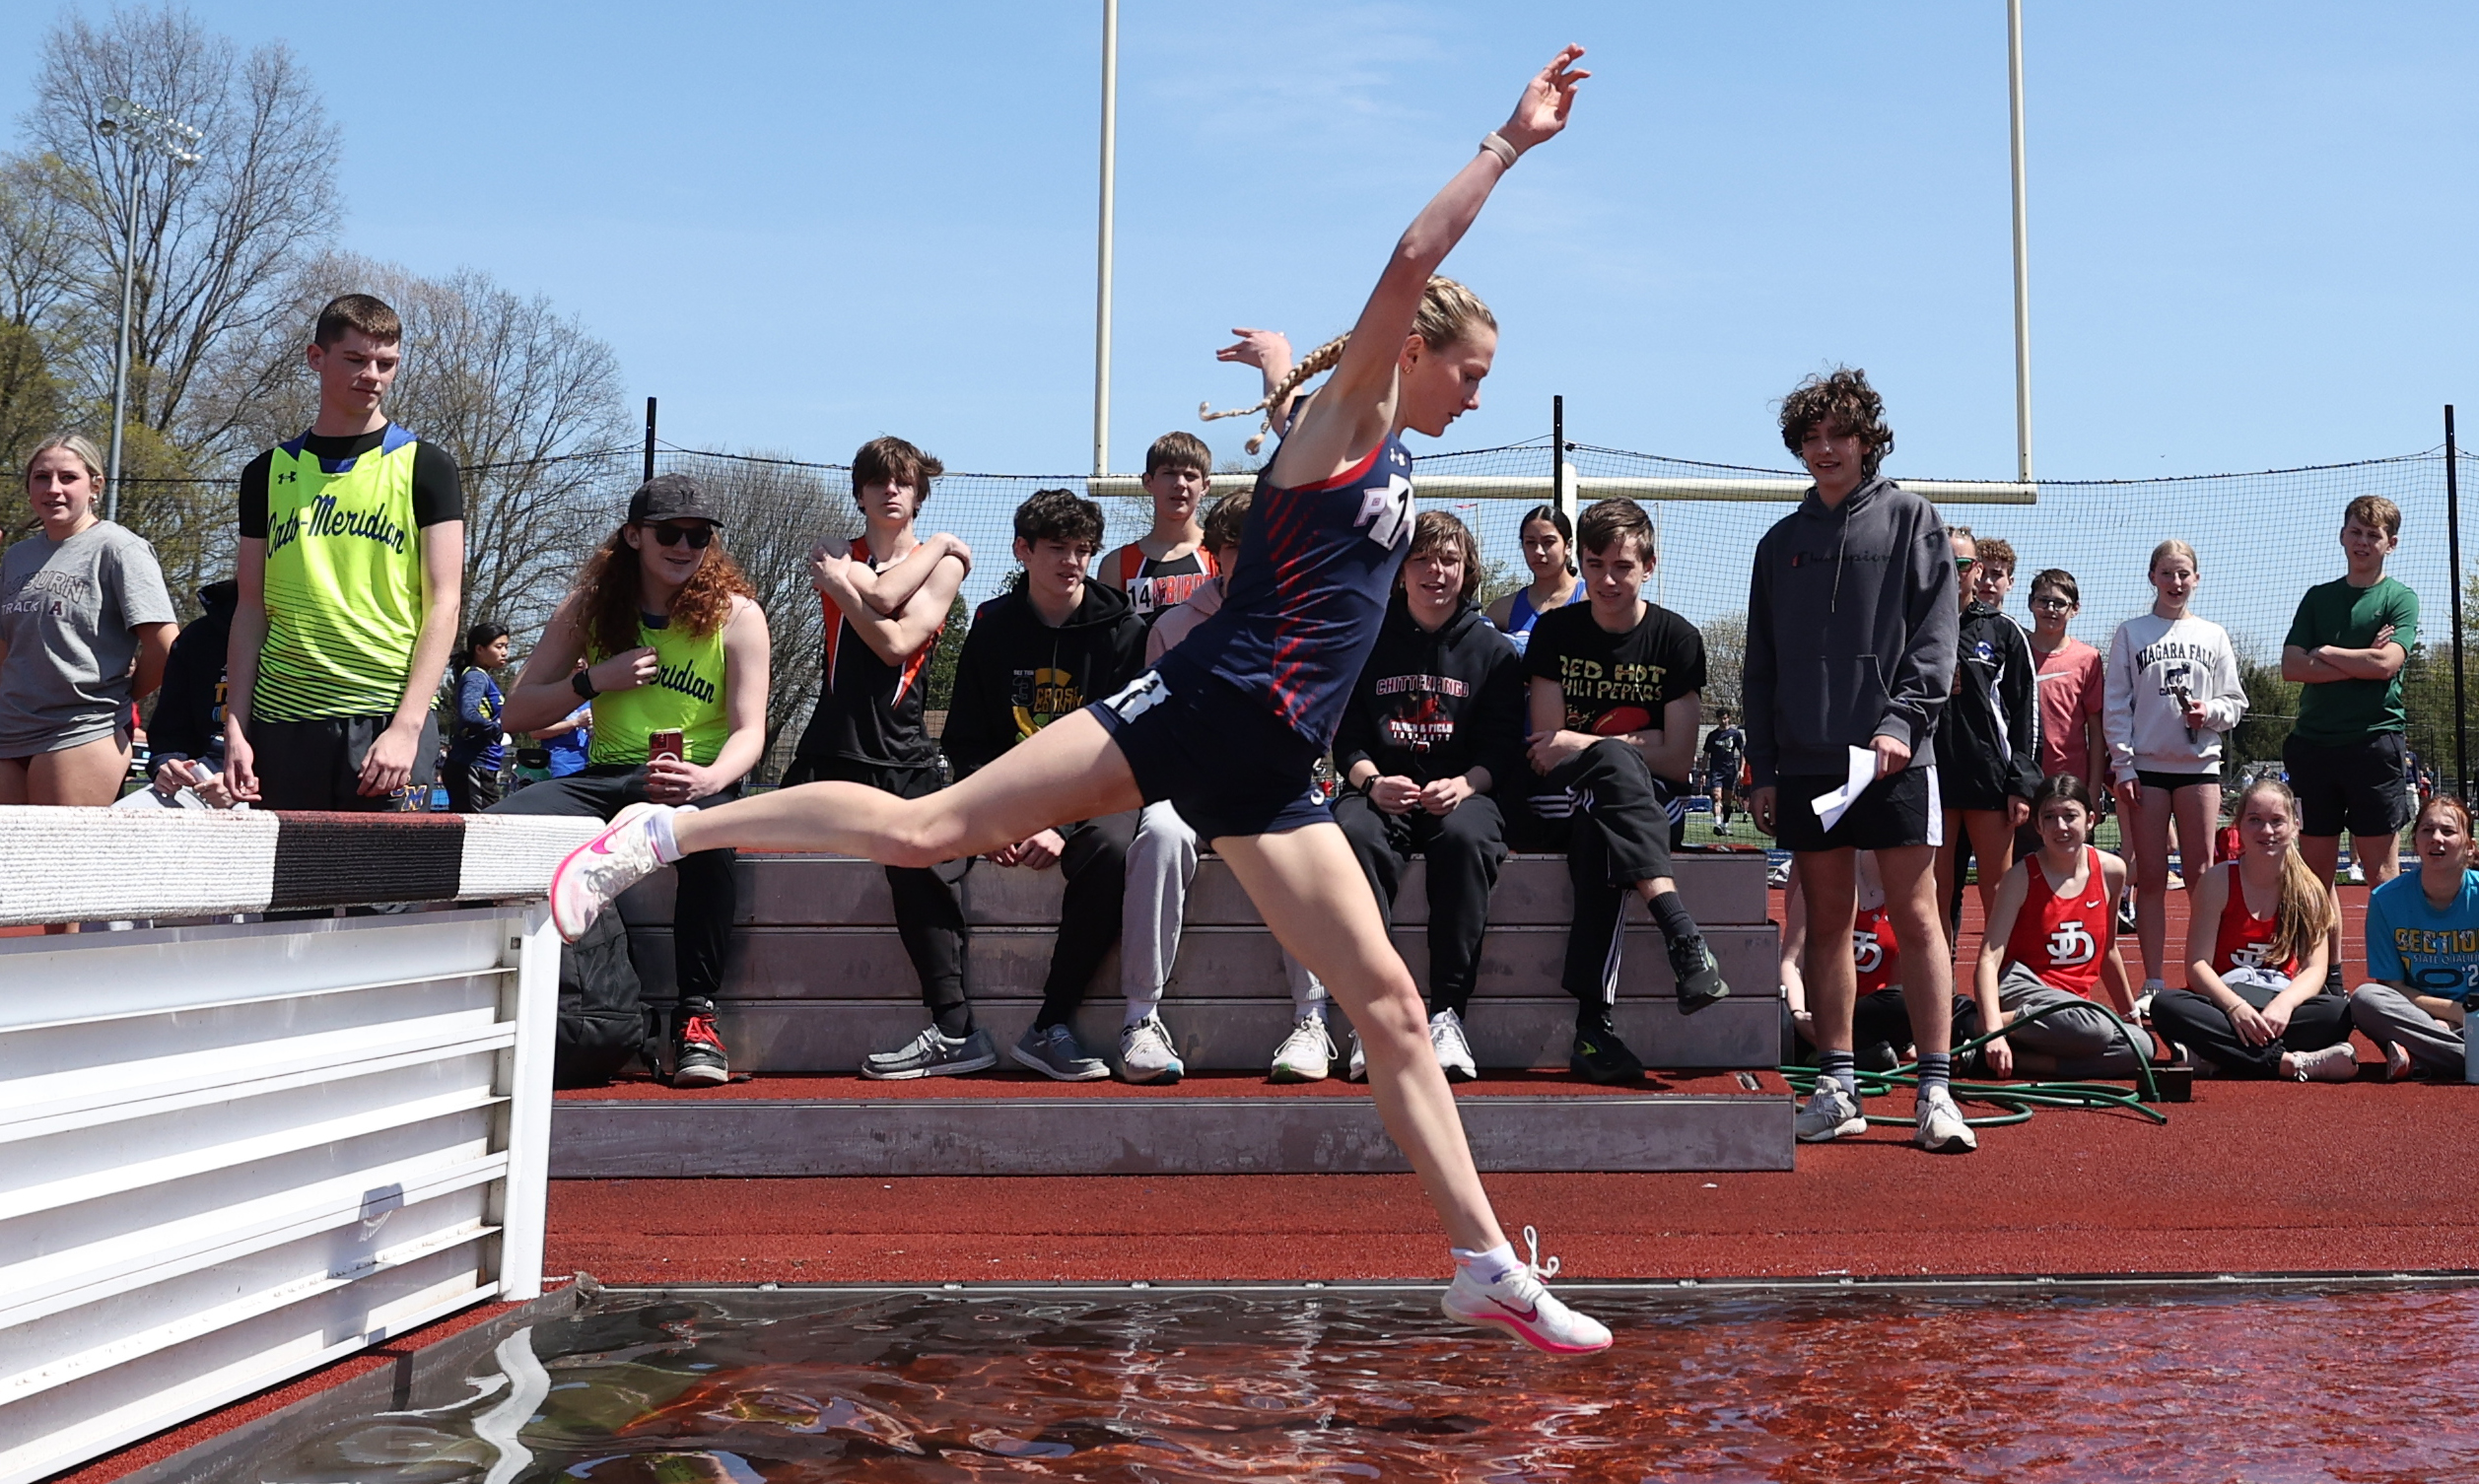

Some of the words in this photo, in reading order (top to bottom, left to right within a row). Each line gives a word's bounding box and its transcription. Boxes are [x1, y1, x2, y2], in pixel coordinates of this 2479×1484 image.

[266, 494, 405, 560] Cato-Meridian
[1, 599, 40, 615] TRACK
[1128, 584, 1152, 609] 14
[2135, 642, 2186, 675] NIAGARA
[1614, 662, 1668, 684] HOT
[1561, 677, 1593, 698] HILI
[2394, 927, 2479, 954] SECTIO
[2413, 954, 2440, 965] STATE
[2441, 953, 2479, 966] QUALIFI
